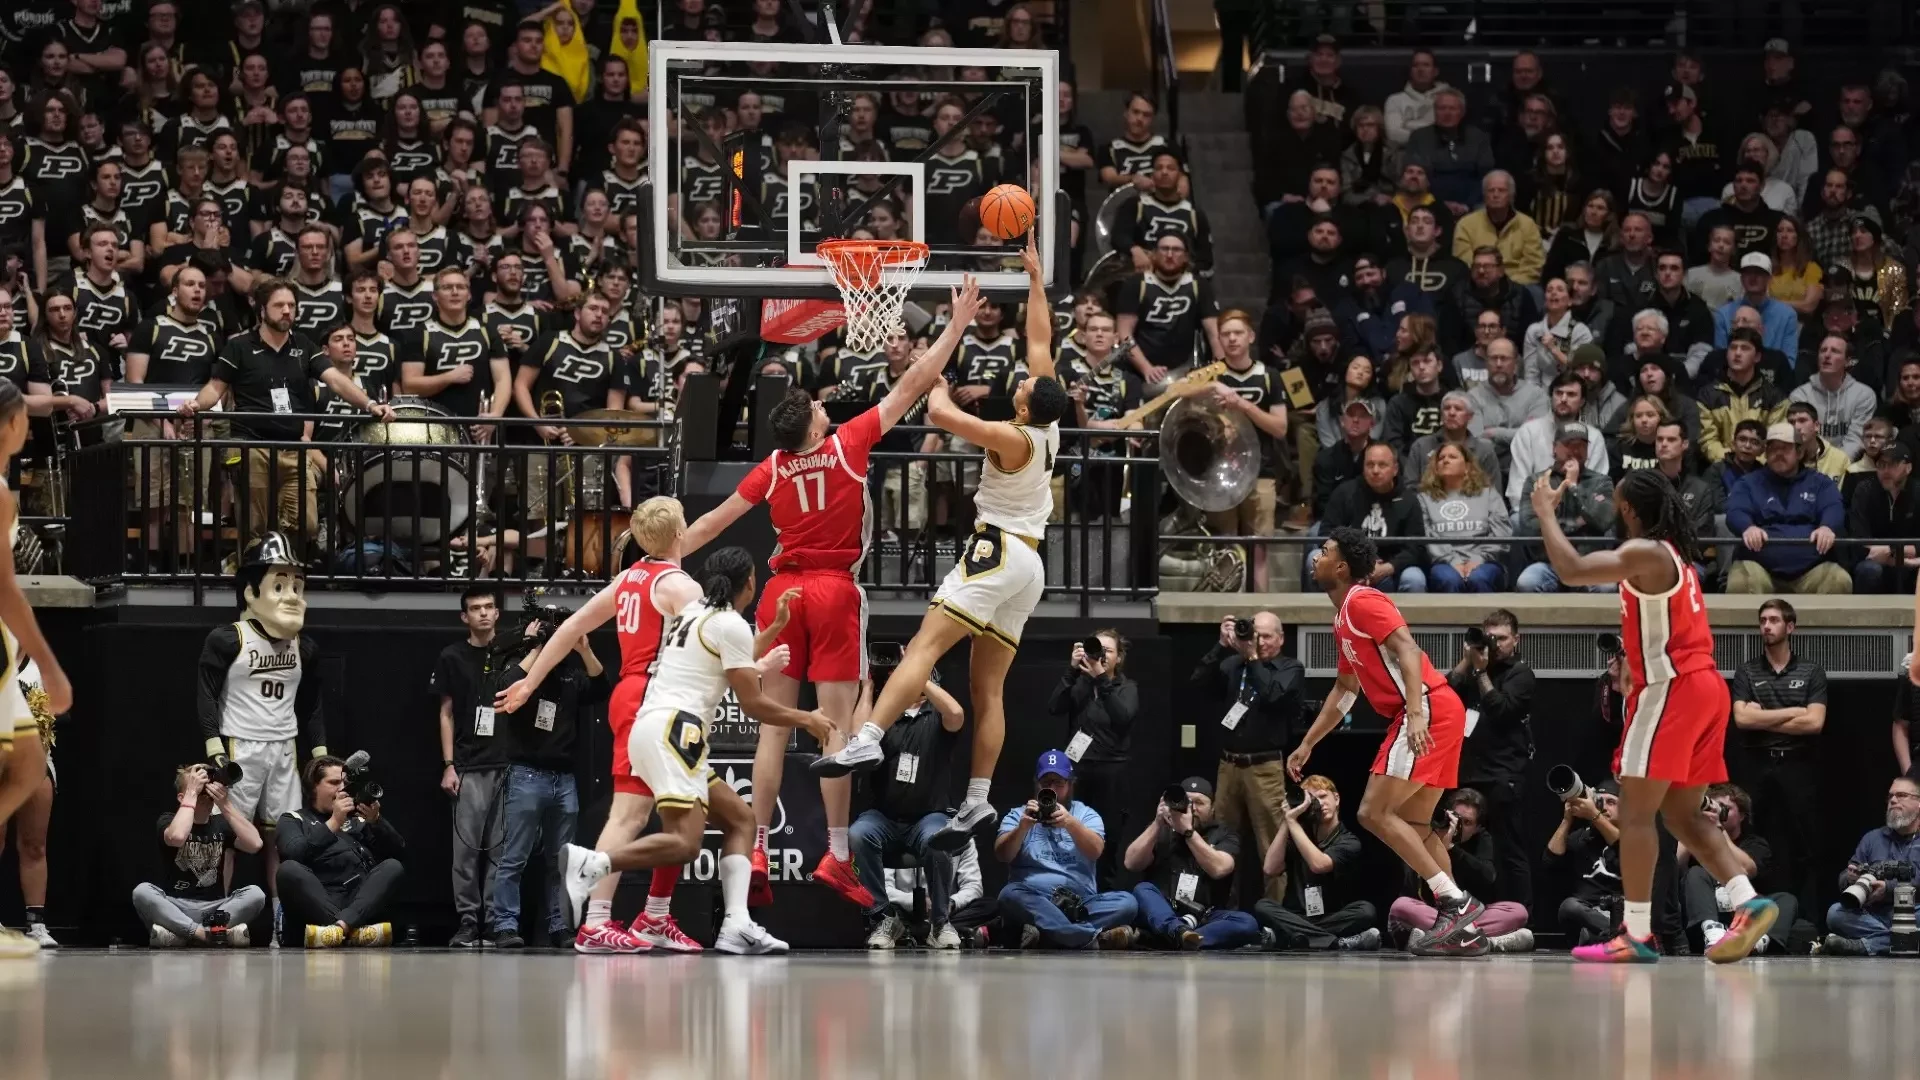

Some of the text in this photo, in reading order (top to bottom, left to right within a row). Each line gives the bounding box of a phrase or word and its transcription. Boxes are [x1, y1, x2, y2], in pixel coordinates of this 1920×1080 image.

[37, 155, 82, 178] P
[391, 152, 433, 171] P
[120, 181, 161, 207] P
[926, 168, 973, 194] P
[79, 302, 123, 330] P
[298, 300, 338, 328] P
[390, 302, 433, 330] P
[1146, 295, 1191, 323] P
[160, 335, 208, 362] P
[437, 340, 482, 370] P
[59, 358, 96, 385] P
[352, 350, 389, 377] P
[553, 354, 604, 383] P
[792, 470, 825, 513] 17
[973, 539, 994, 563] P
[617, 591, 641, 634] 20
[665, 615, 698, 648] 24
[248, 650, 298, 671] Purdue
[261, 680, 284, 700] 00
[681, 722, 701, 750] P
